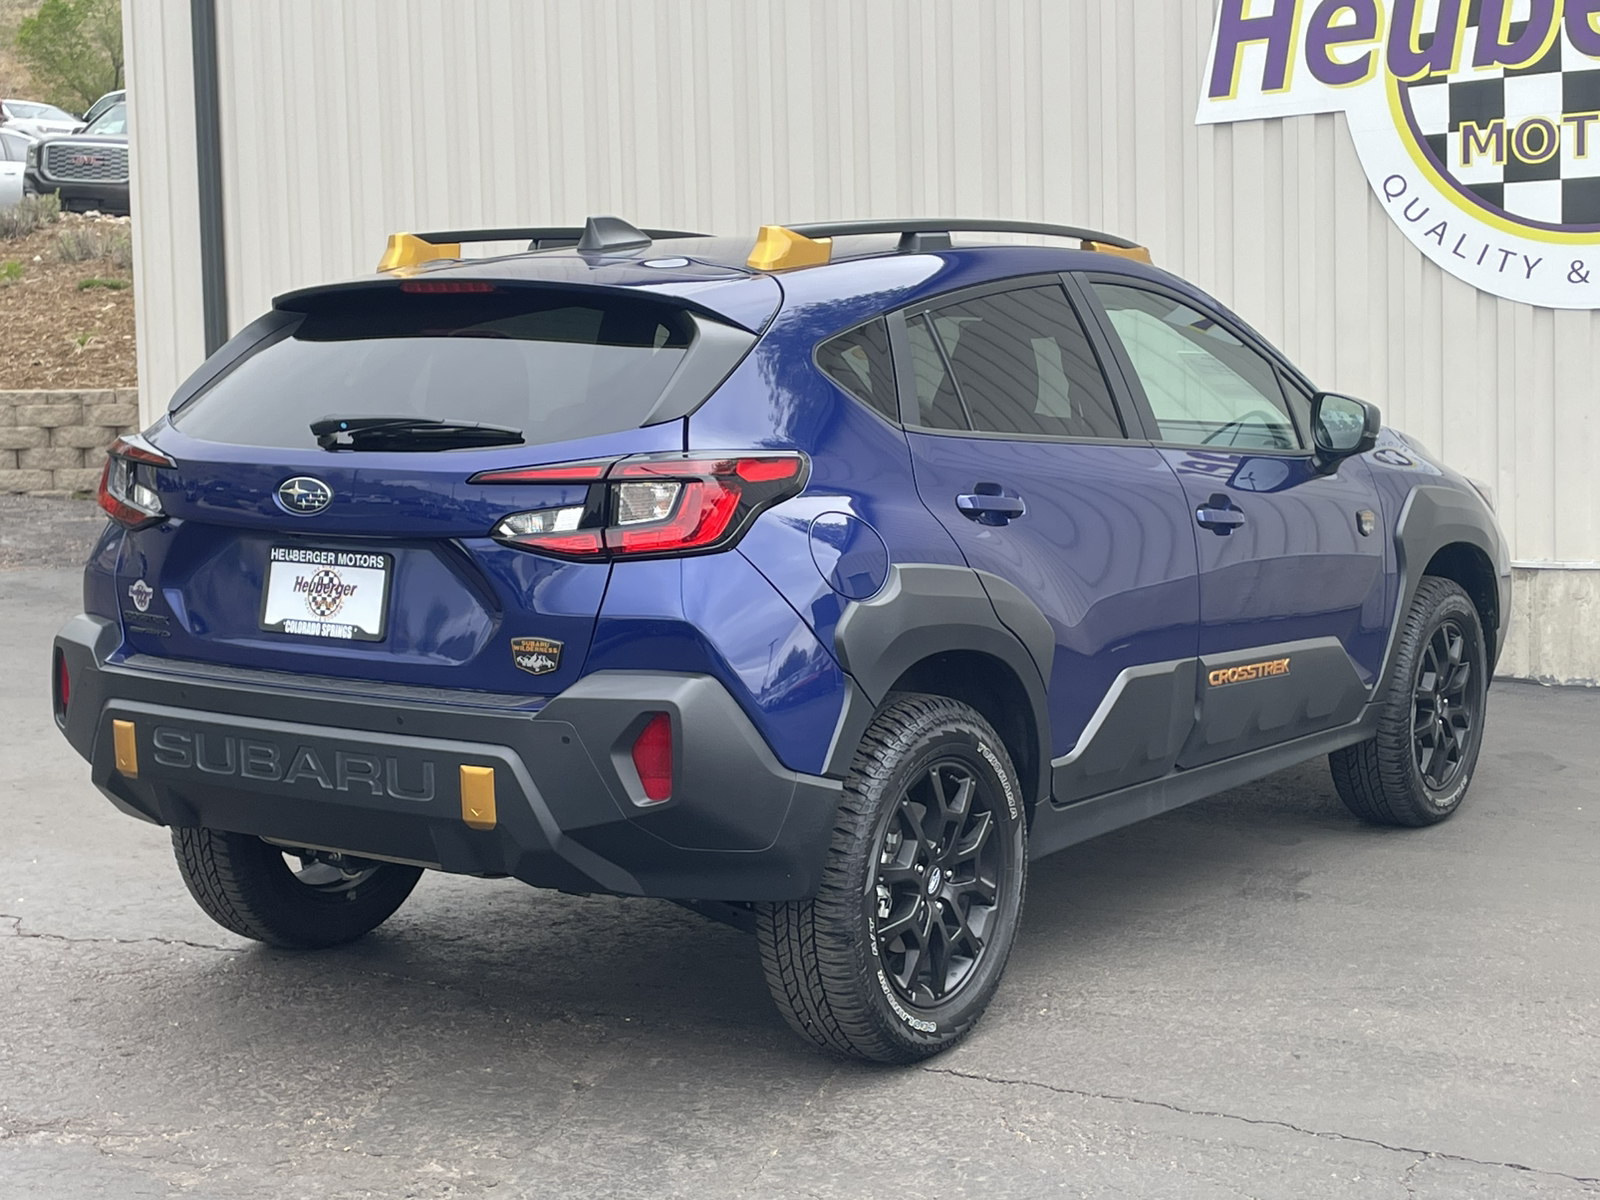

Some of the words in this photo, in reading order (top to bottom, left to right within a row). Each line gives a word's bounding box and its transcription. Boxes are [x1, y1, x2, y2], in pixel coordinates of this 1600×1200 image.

[1383, 175, 1543, 279] QUALITY
[1567, 260, 1590, 283] &
[271, 548, 335, 564] HEUBERGER
[338, 553, 384, 568] MOTORS
[293, 576, 358, 600] Heuberger
[284, 620, 320, 636] COLORADO
[321, 623, 353, 639] SPRINGS
[512, 645, 558, 653] WILDERNESS
[1208, 658, 1290, 686] CROSSTREK
[152, 725, 435, 801] SUBARU
[977, 742, 1018, 820] YOKOHAMA
